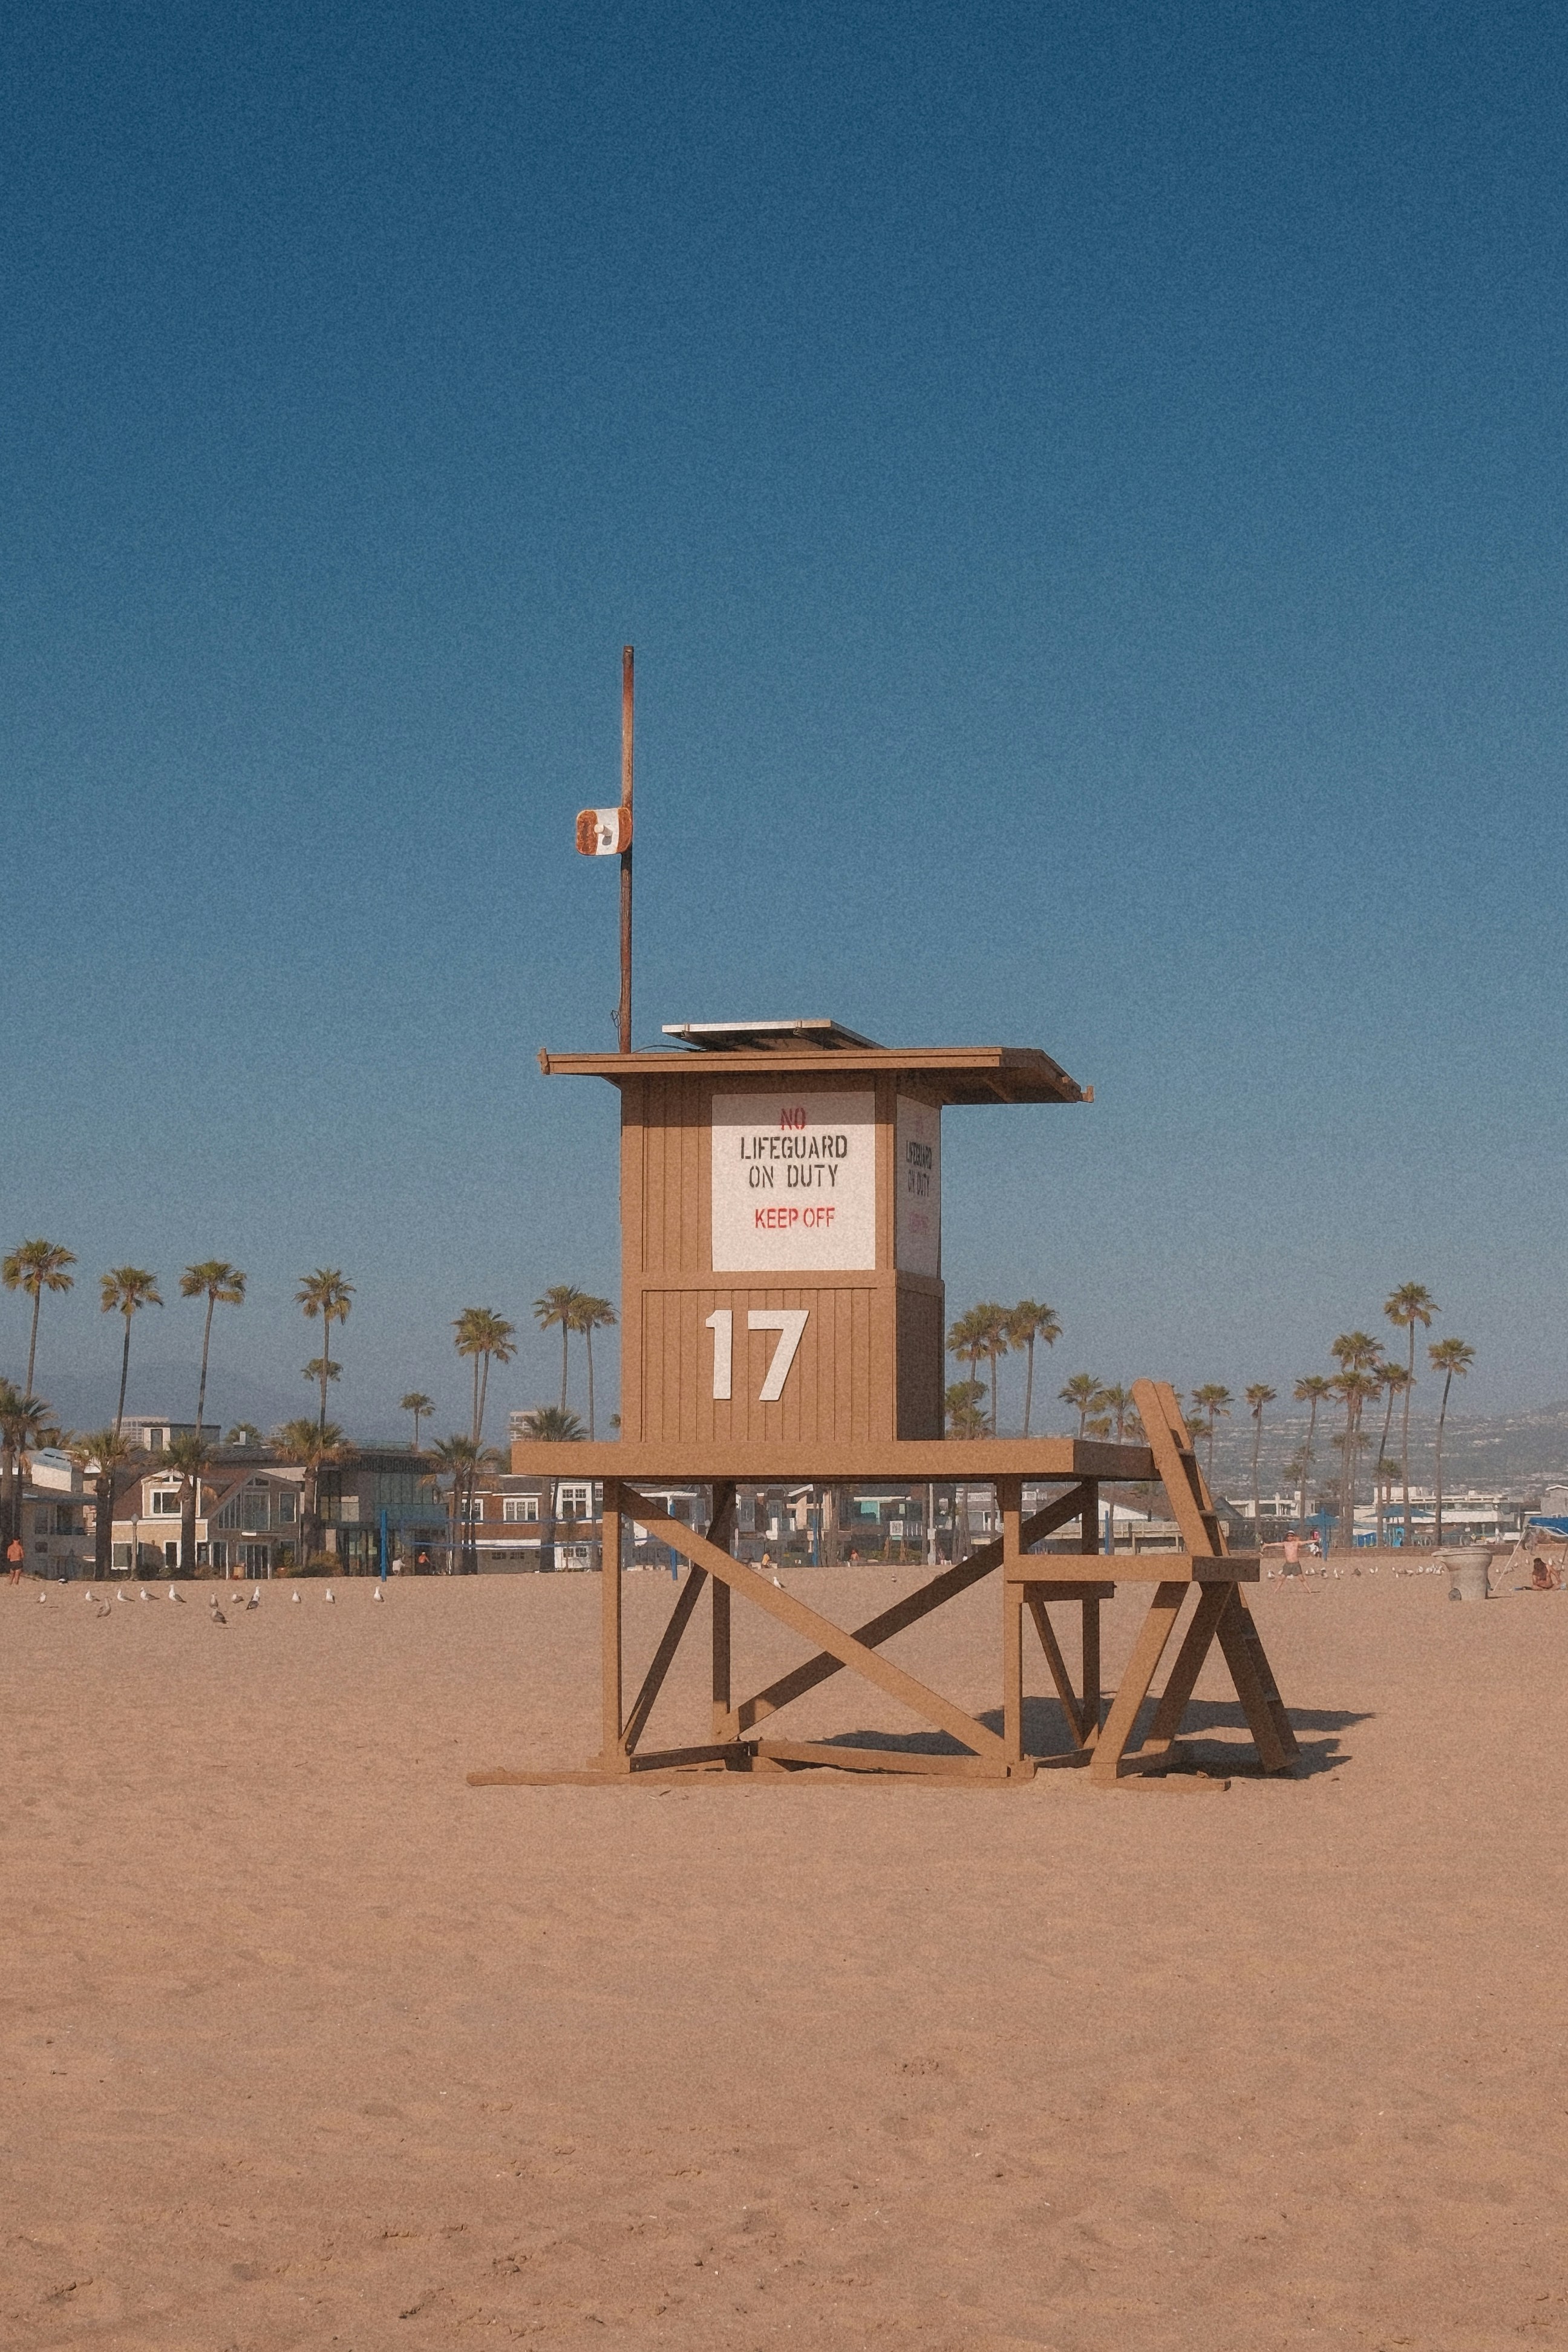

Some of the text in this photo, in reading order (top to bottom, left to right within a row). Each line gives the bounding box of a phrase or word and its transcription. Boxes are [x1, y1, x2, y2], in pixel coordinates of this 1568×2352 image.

[780, 1108, 806, 1130] NO
[741, 1135, 847, 1159] LIFEGUARD
[906, 1140, 932, 1170] LIFEGUARD
[749, 1165, 838, 1187] ON DUTY
[908, 1169, 930, 1197] ON DUTY
[755, 1207, 835, 1228] KEEP OFF
[705, 1310, 809, 1400] 17
